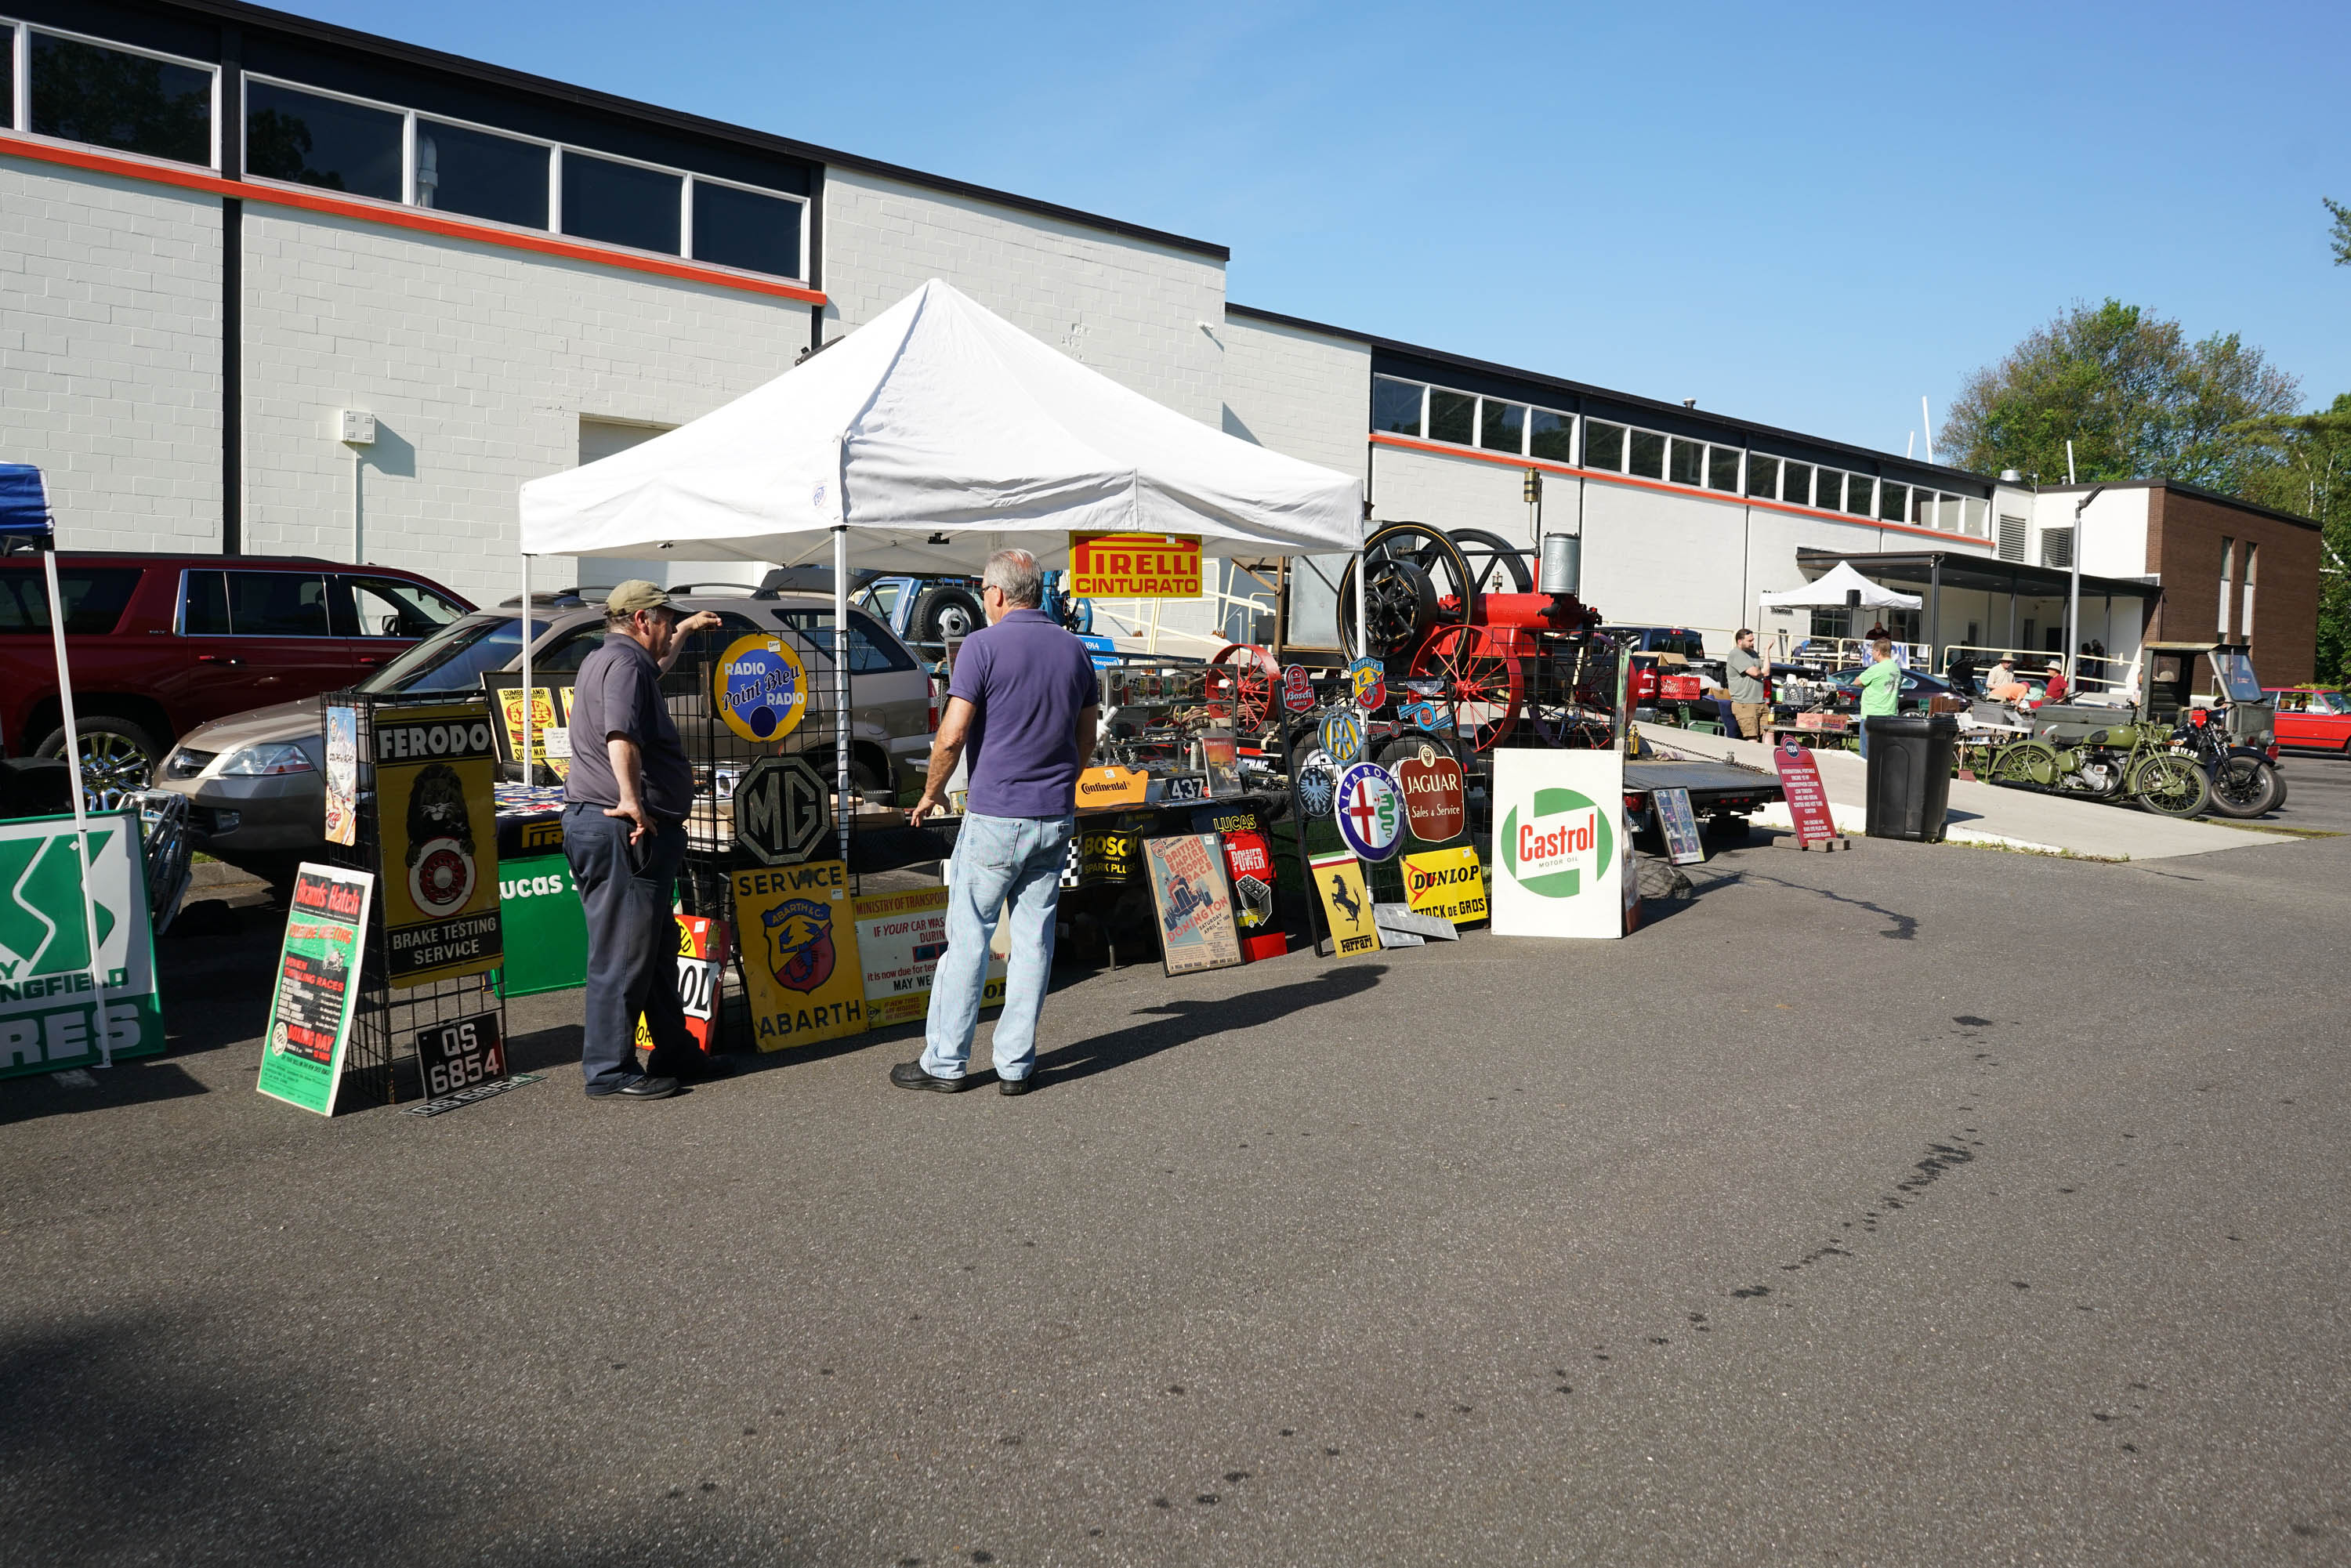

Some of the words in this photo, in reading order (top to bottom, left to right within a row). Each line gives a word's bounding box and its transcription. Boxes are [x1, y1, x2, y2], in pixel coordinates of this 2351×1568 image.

[1075, 536, 1199, 574] PIRELLI
[1076, 578, 1198, 593] CINTURATO
[1085, 642, 1099, 650] 1914
[724, 662, 766, 675] RADIO
[722, 679, 763, 712] Point
[764, 664, 801, 691] Bleu
[766, 692, 805, 705] RADIO
[1285, 690, 1313, 701] Bosch
[379, 723, 490, 759] FERODO
[1081, 781, 1128, 795] Continental
[1172, 777, 1204, 798] 437
[1342, 773, 1360, 816] ALFA
[1363, 766, 1405, 813] ROMEO
[1407, 773, 1458, 795] JAGUAR
[748, 771, 817, 849] MG
[1411, 805, 1429, 818] Sales
[1436, 803, 1460, 816] Service
[1213, 814, 1256, 833] LUCAS
[1085, 835, 1138, 856] BOSCH
[1520, 813, 1594, 862] Castrol
[1165, 836, 1201, 864] BRITISH
[1168, 845, 1206, 872] EMPIRE
[1230, 848, 1266, 872] POWER
[1085, 862, 1109, 874] SPARK
[1110, 862, 1136, 874] PLUGS
[1175, 853, 1208, 877] TROPHY
[1185, 861, 1213, 884] RACE
[1538, 859, 1563, 868] MOTOR
[499, 875, 563, 900] ucas
[739, 866, 843, 896] SERVICE
[1414, 865, 1479, 889] DUNLOP
[328, 884, 360, 915] Hatch
[856, 899, 893, 915] MINISTRY
[894, 898, 905, 910] OF
[905, 889, 949, 909] TRANSPORT
[1447, 906, 1458, 917] DE
[1459, 898, 1485, 915] GROS
[772, 903, 808, 924] ABARTH
[1166, 896, 1229, 943] DONINGTON
[1199, 913, 1223, 931] SATURDAY
[393, 928, 439, 951] BRAKE
[442, 917, 496, 940] TESTING
[874, 925, 880, 937] IF
[882, 922, 909, 936] YOUR
[911, 920, 926, 932] CAR
[927, 917, 945, 928] WAS
[919, 929, 946, 943] DURIN
[1204, 924, 1217, 935] APRIL
[414, 939, 480, 965] SERVICE
[1340, 935, 1373, 953] Ferrari
[994, 952, 1005, 961] law
[316, 976, 345, 992] RACES
[868, 972, 872, 982] it
[873, 971, 880, 980] is
[882, 969, 896, 979] now
[897, 966, 911, 976] due
[912, 965, 923, 975] for
[893, 978, 913, 991] MAY
[917, 976, 931, 987] WE
[759, 999, 860, 1040] ABARTH
[288, 1023, 315, 1047] BOXING
[314, 1032, 335, 1052] DAY
[442, 1023, 477, 1056] QS
[431, 1048, 499, 1094] 6854
[454, 1076, 534, 1099] 6854
